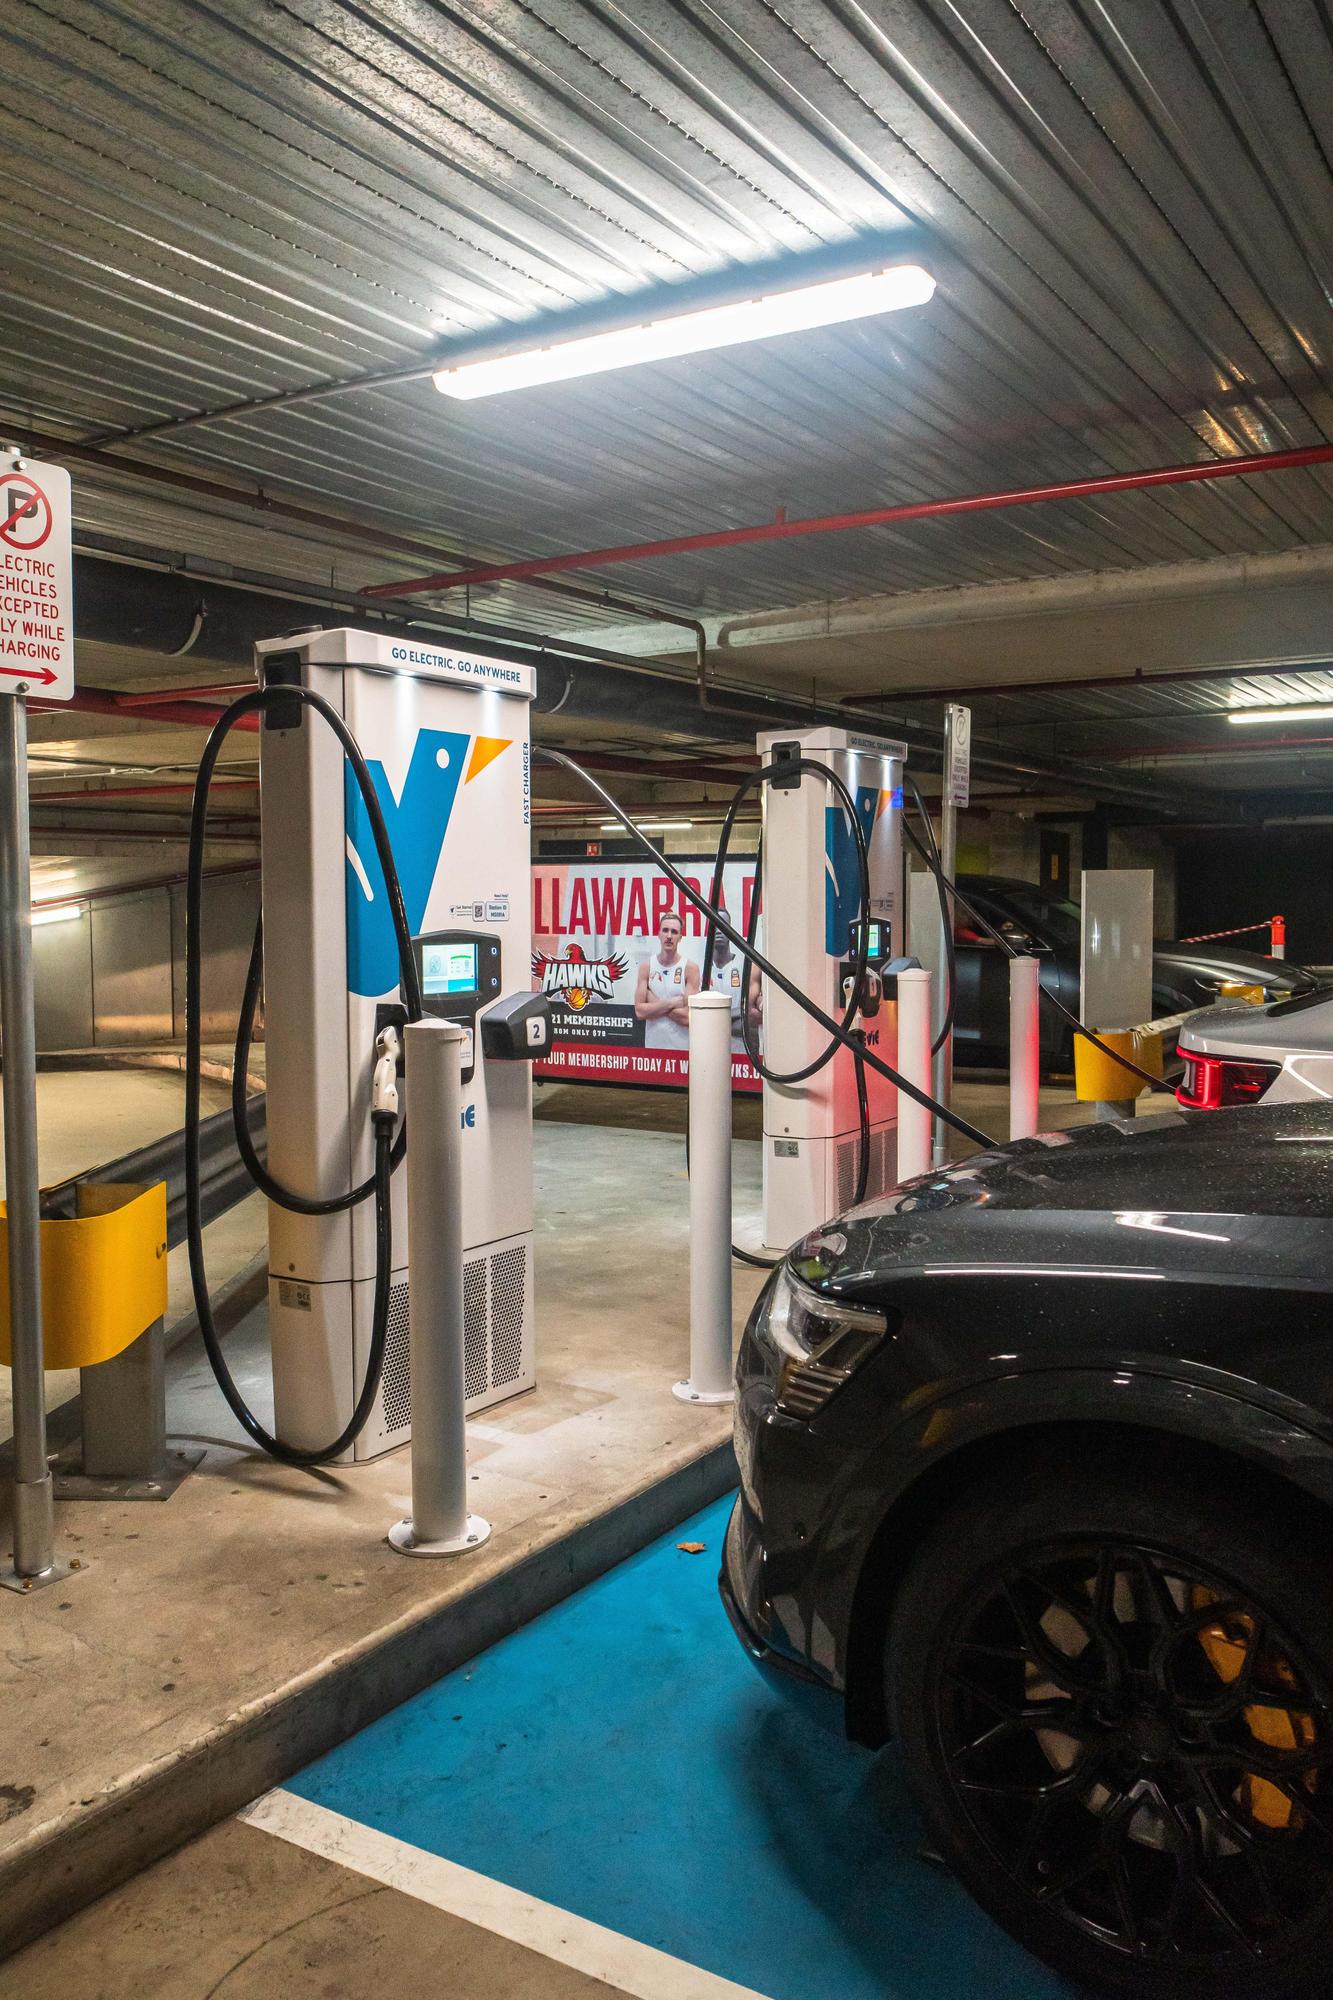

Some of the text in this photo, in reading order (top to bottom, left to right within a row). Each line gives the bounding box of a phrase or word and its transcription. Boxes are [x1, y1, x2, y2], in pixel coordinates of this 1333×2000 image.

[0, 554, 55, 578] ECTRIC
[0, 595, 59, 620] CEPTED
[22, 621, 65, 641] WHILE
[391, 647, 521, 683] GO ELECTRIC. GO ANYWHERE
[542, 963, 614, 996] HAWKS
[533, 1024, 540, 1039] 2
[564, 1015, 634, 1028] MEMBERSHIPS
[568, 1053, 629, 1068] MEMBERSHIP
[632, 1057, 662, 1073] TODAY
[664, 1059, 676, 1073] AT
